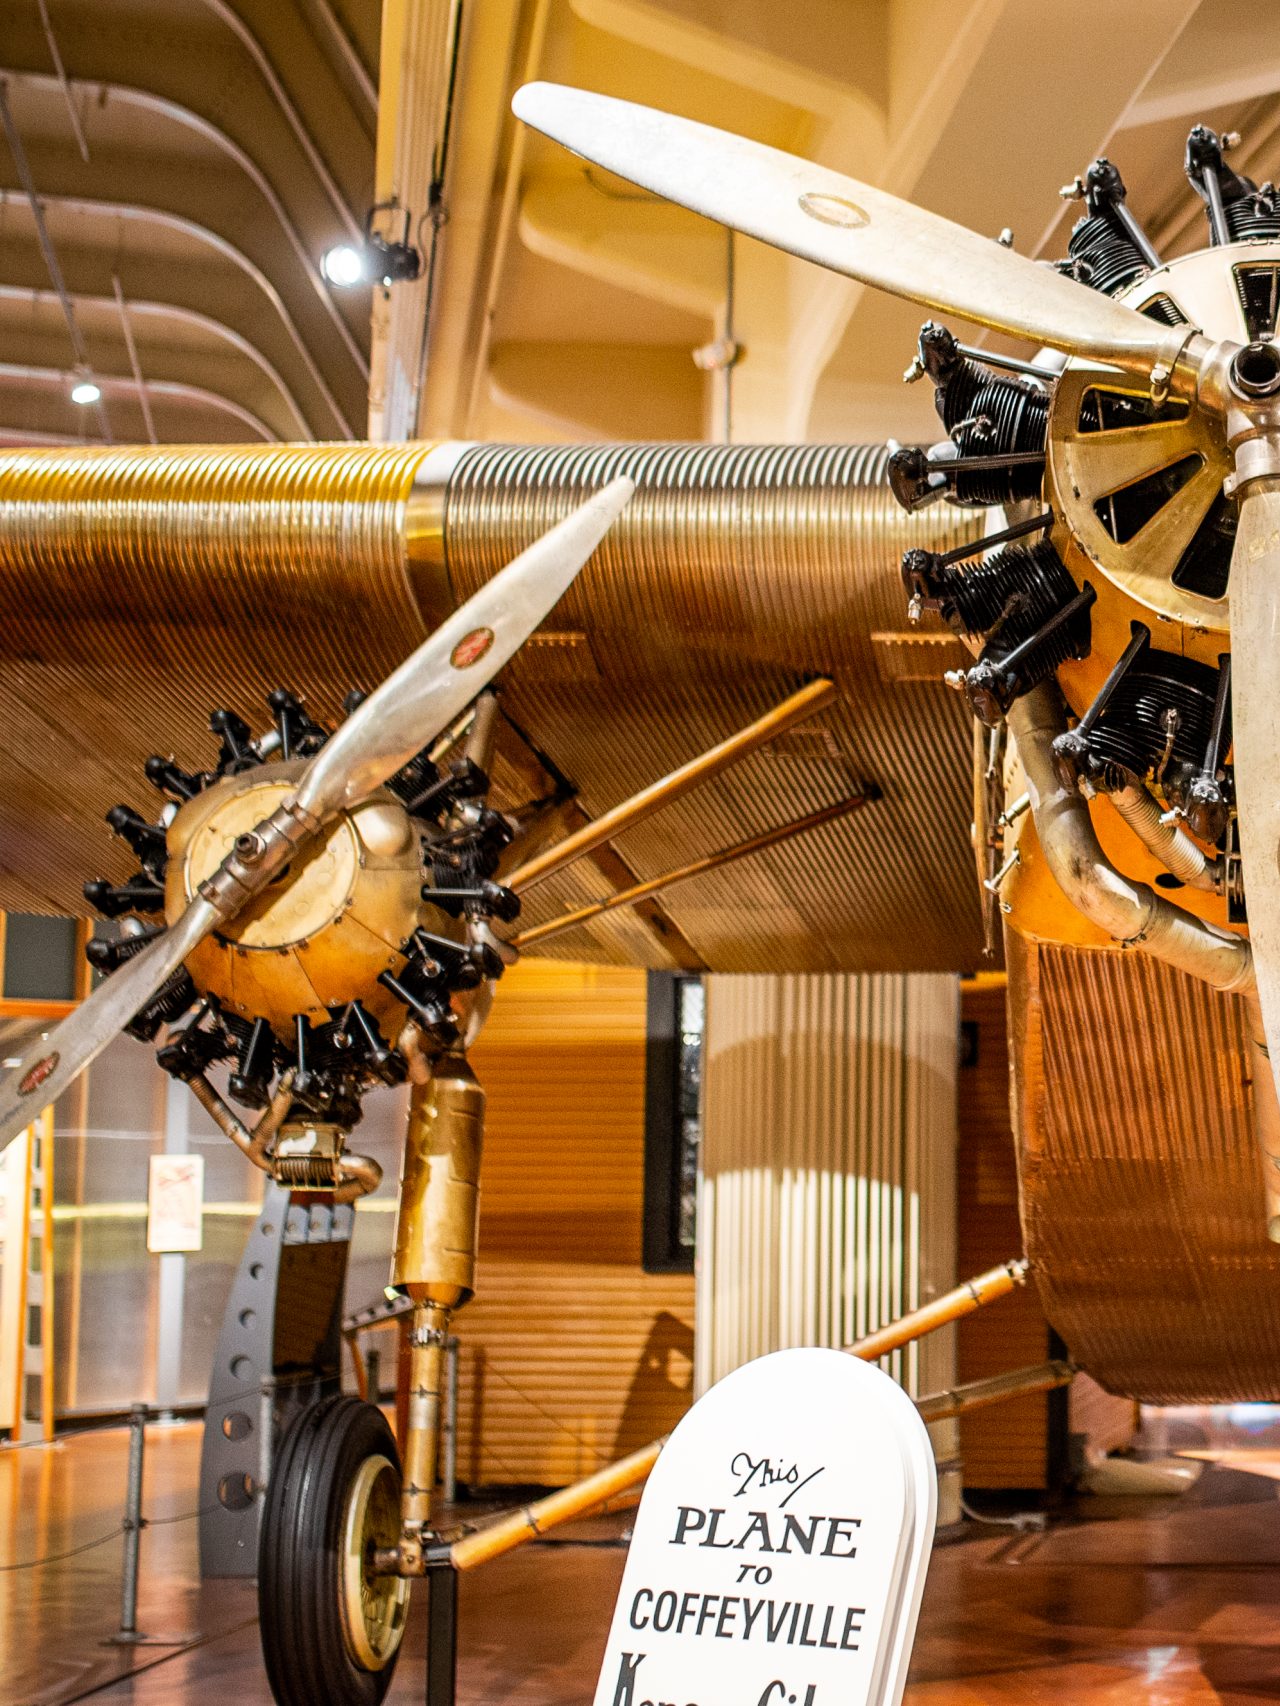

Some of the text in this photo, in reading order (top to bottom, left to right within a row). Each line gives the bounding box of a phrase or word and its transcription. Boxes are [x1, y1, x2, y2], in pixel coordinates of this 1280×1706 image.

[668, 1506, 862, 1559] PLANE
[735, 1564, 773, 1585] TO
[629, 1588, 866, 1651] COFFEYVILLE
